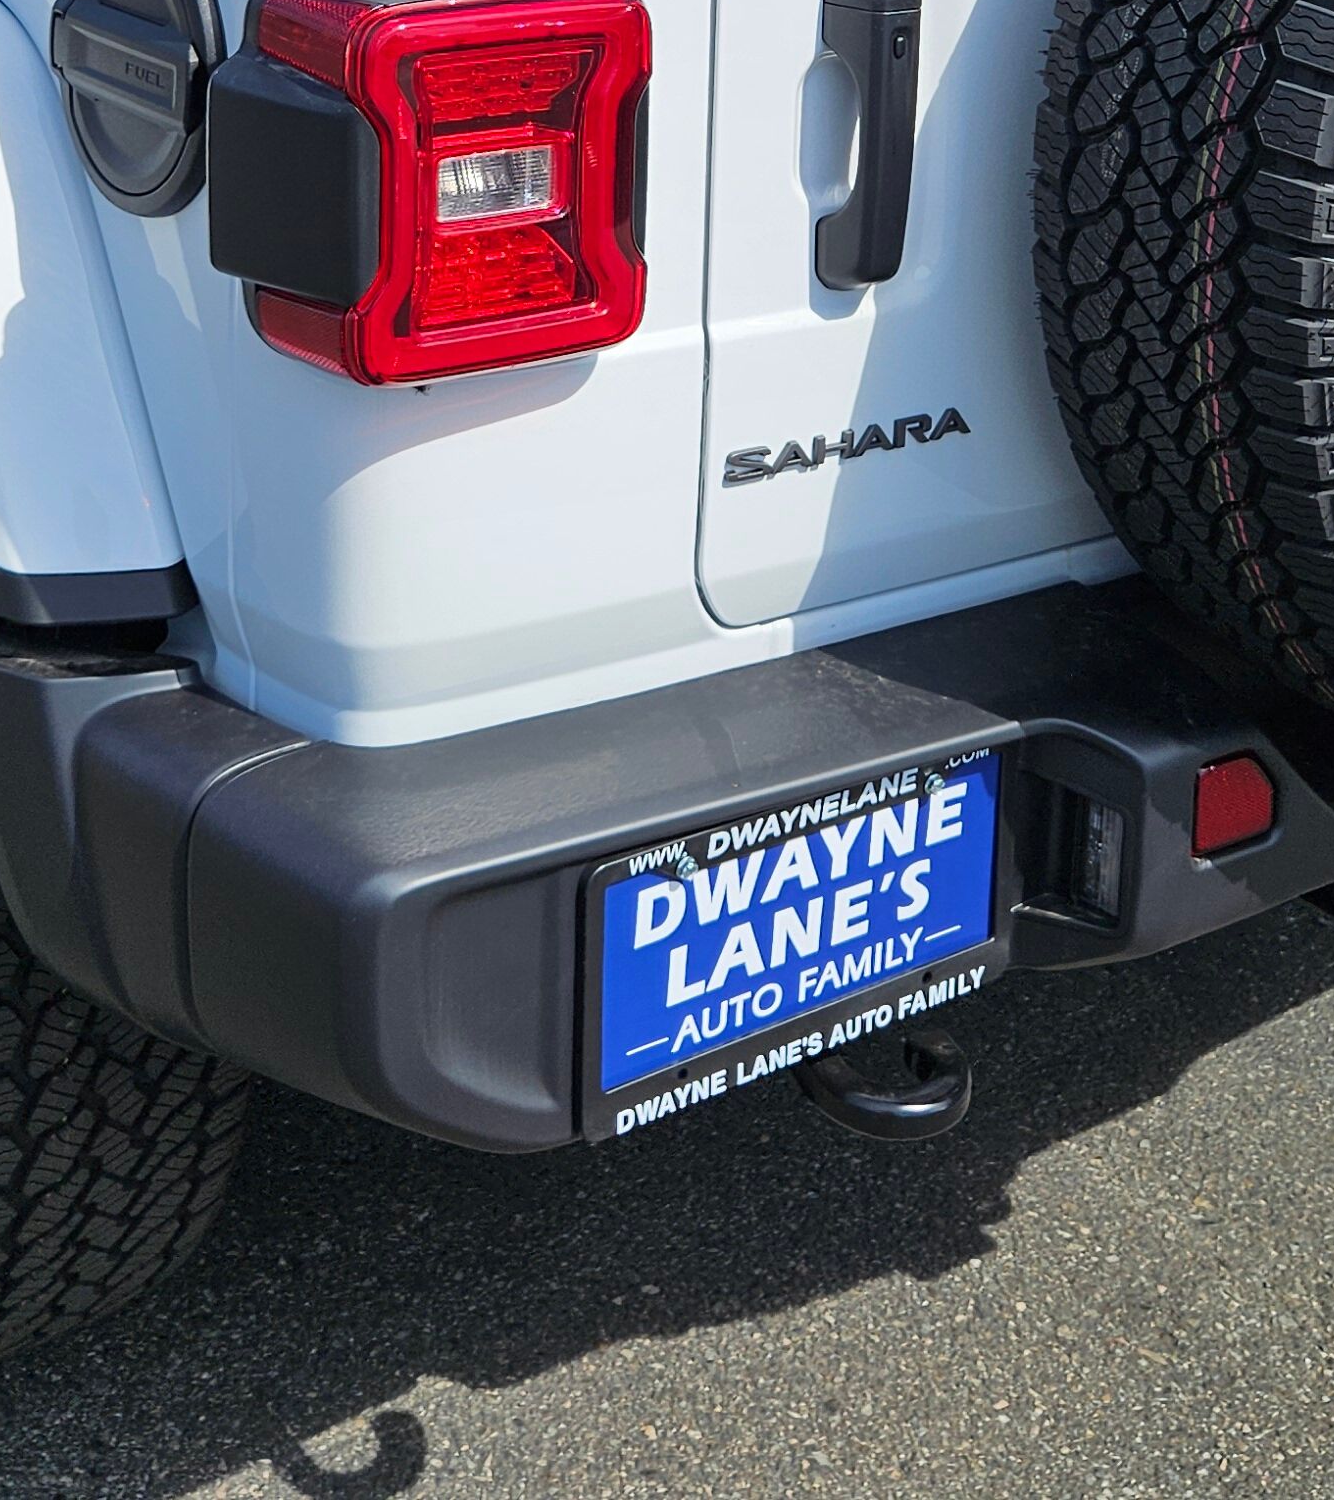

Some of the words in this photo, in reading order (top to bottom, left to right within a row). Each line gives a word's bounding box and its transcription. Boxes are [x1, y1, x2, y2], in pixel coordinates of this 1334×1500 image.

[124, 61, 166, 90] FUEL
[724, 406, 972, 483] SAHARA
[634, 782, 968, 950] DWAYNE
[707, 767, 931, 859] DWAYNELANE
[667, 858, 932, 1008] LANE'S
[671, 982, 784, 1053] AUTO
[798, 926, 925, 1003] FAMILY
[616, 1070, 728, 1136] DWAYNE
[736, 1031, 824, 1086] LANE'S
[828, 1003, 892, 1050] AUTO
[898, 964, 987, 1021] FAMILY
